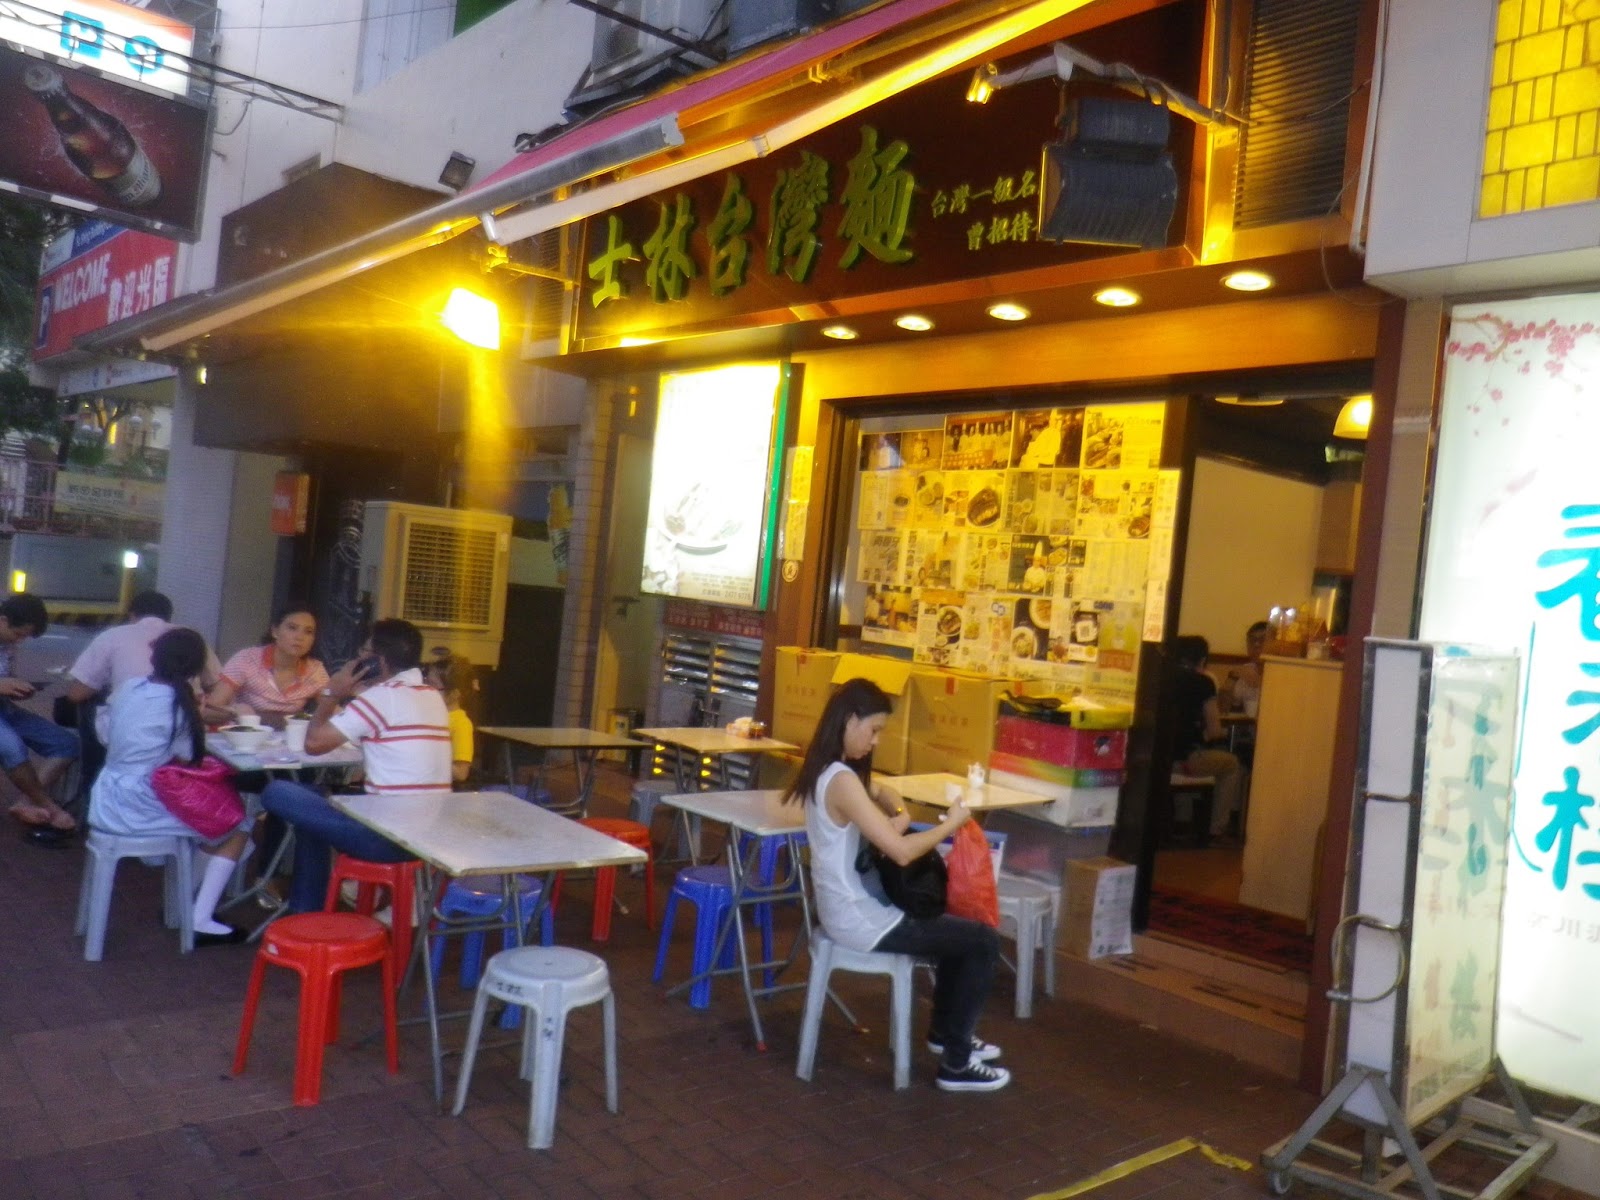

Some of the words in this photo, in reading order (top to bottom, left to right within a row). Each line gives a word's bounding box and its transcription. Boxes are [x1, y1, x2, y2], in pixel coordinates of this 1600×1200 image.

[588, 124, 916, 309] 士林台灣麵
[931, 170, 1040, 218] 台灣一級名
[967, 211, 1040, 250] 曾招待
[54, 253, 111, 313] WELCOME
